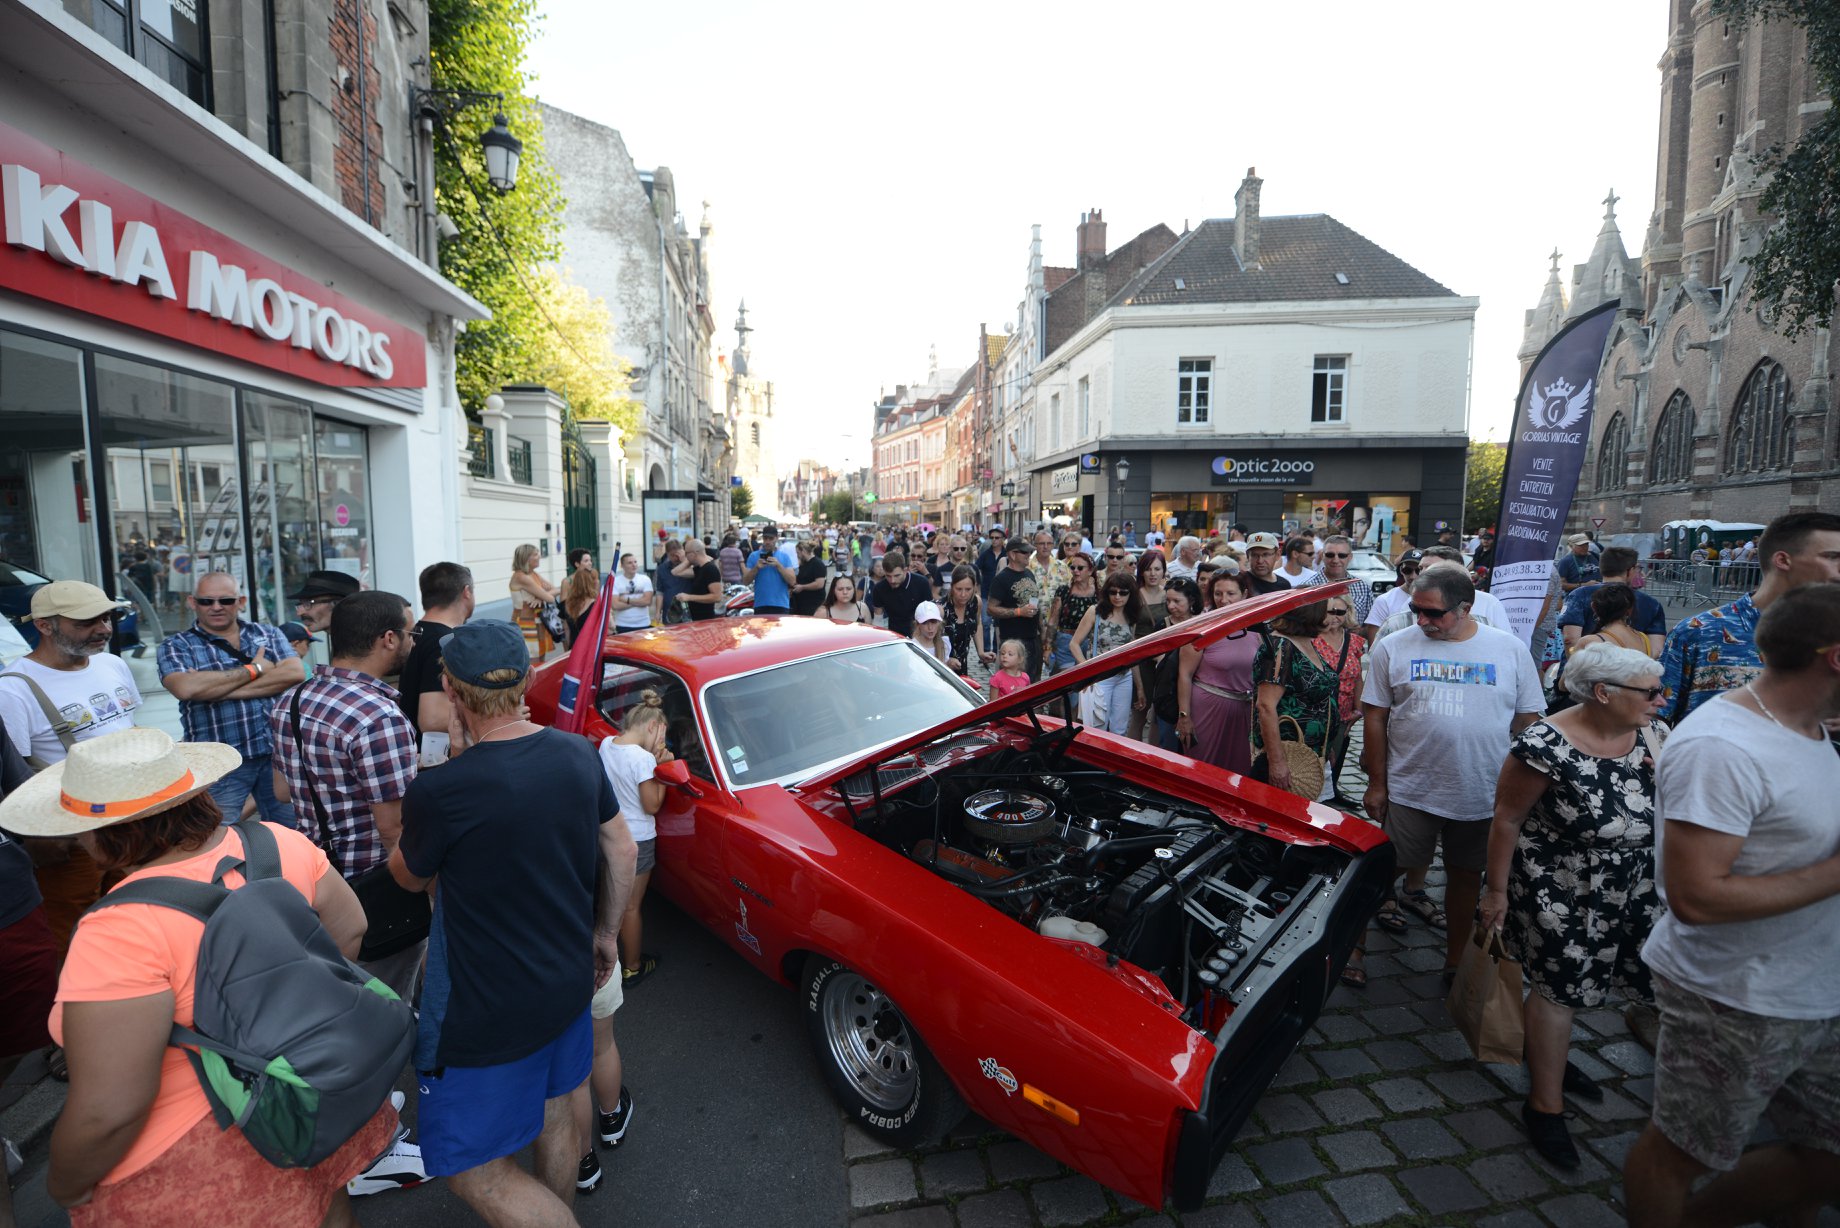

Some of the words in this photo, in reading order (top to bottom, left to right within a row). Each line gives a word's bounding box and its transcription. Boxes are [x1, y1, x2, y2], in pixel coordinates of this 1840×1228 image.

[1, 164, 177, 300] KIA
[187, 250, 394, 380] MOTORS
[1548, 400, 1561, 422] G
[1522, 432, 1551, 442] GORRIAS
[1551, 432, 1582, 443] VINTAGE
[1222, 458, 1269, 477] Optic
[1271, 459, 1314, 473] 2000
[1533, 458, 1554, 471] VENTE
[1520, 480, 1555, 495] ENTRETIEN
[1509, 502, 1558, 520] RESTAURATION
[809, 968, 832, 1012] RADIAL
[995, 1072, 1016, 1087] Gulf
[860, 1106, 902, 1129] COBRA
